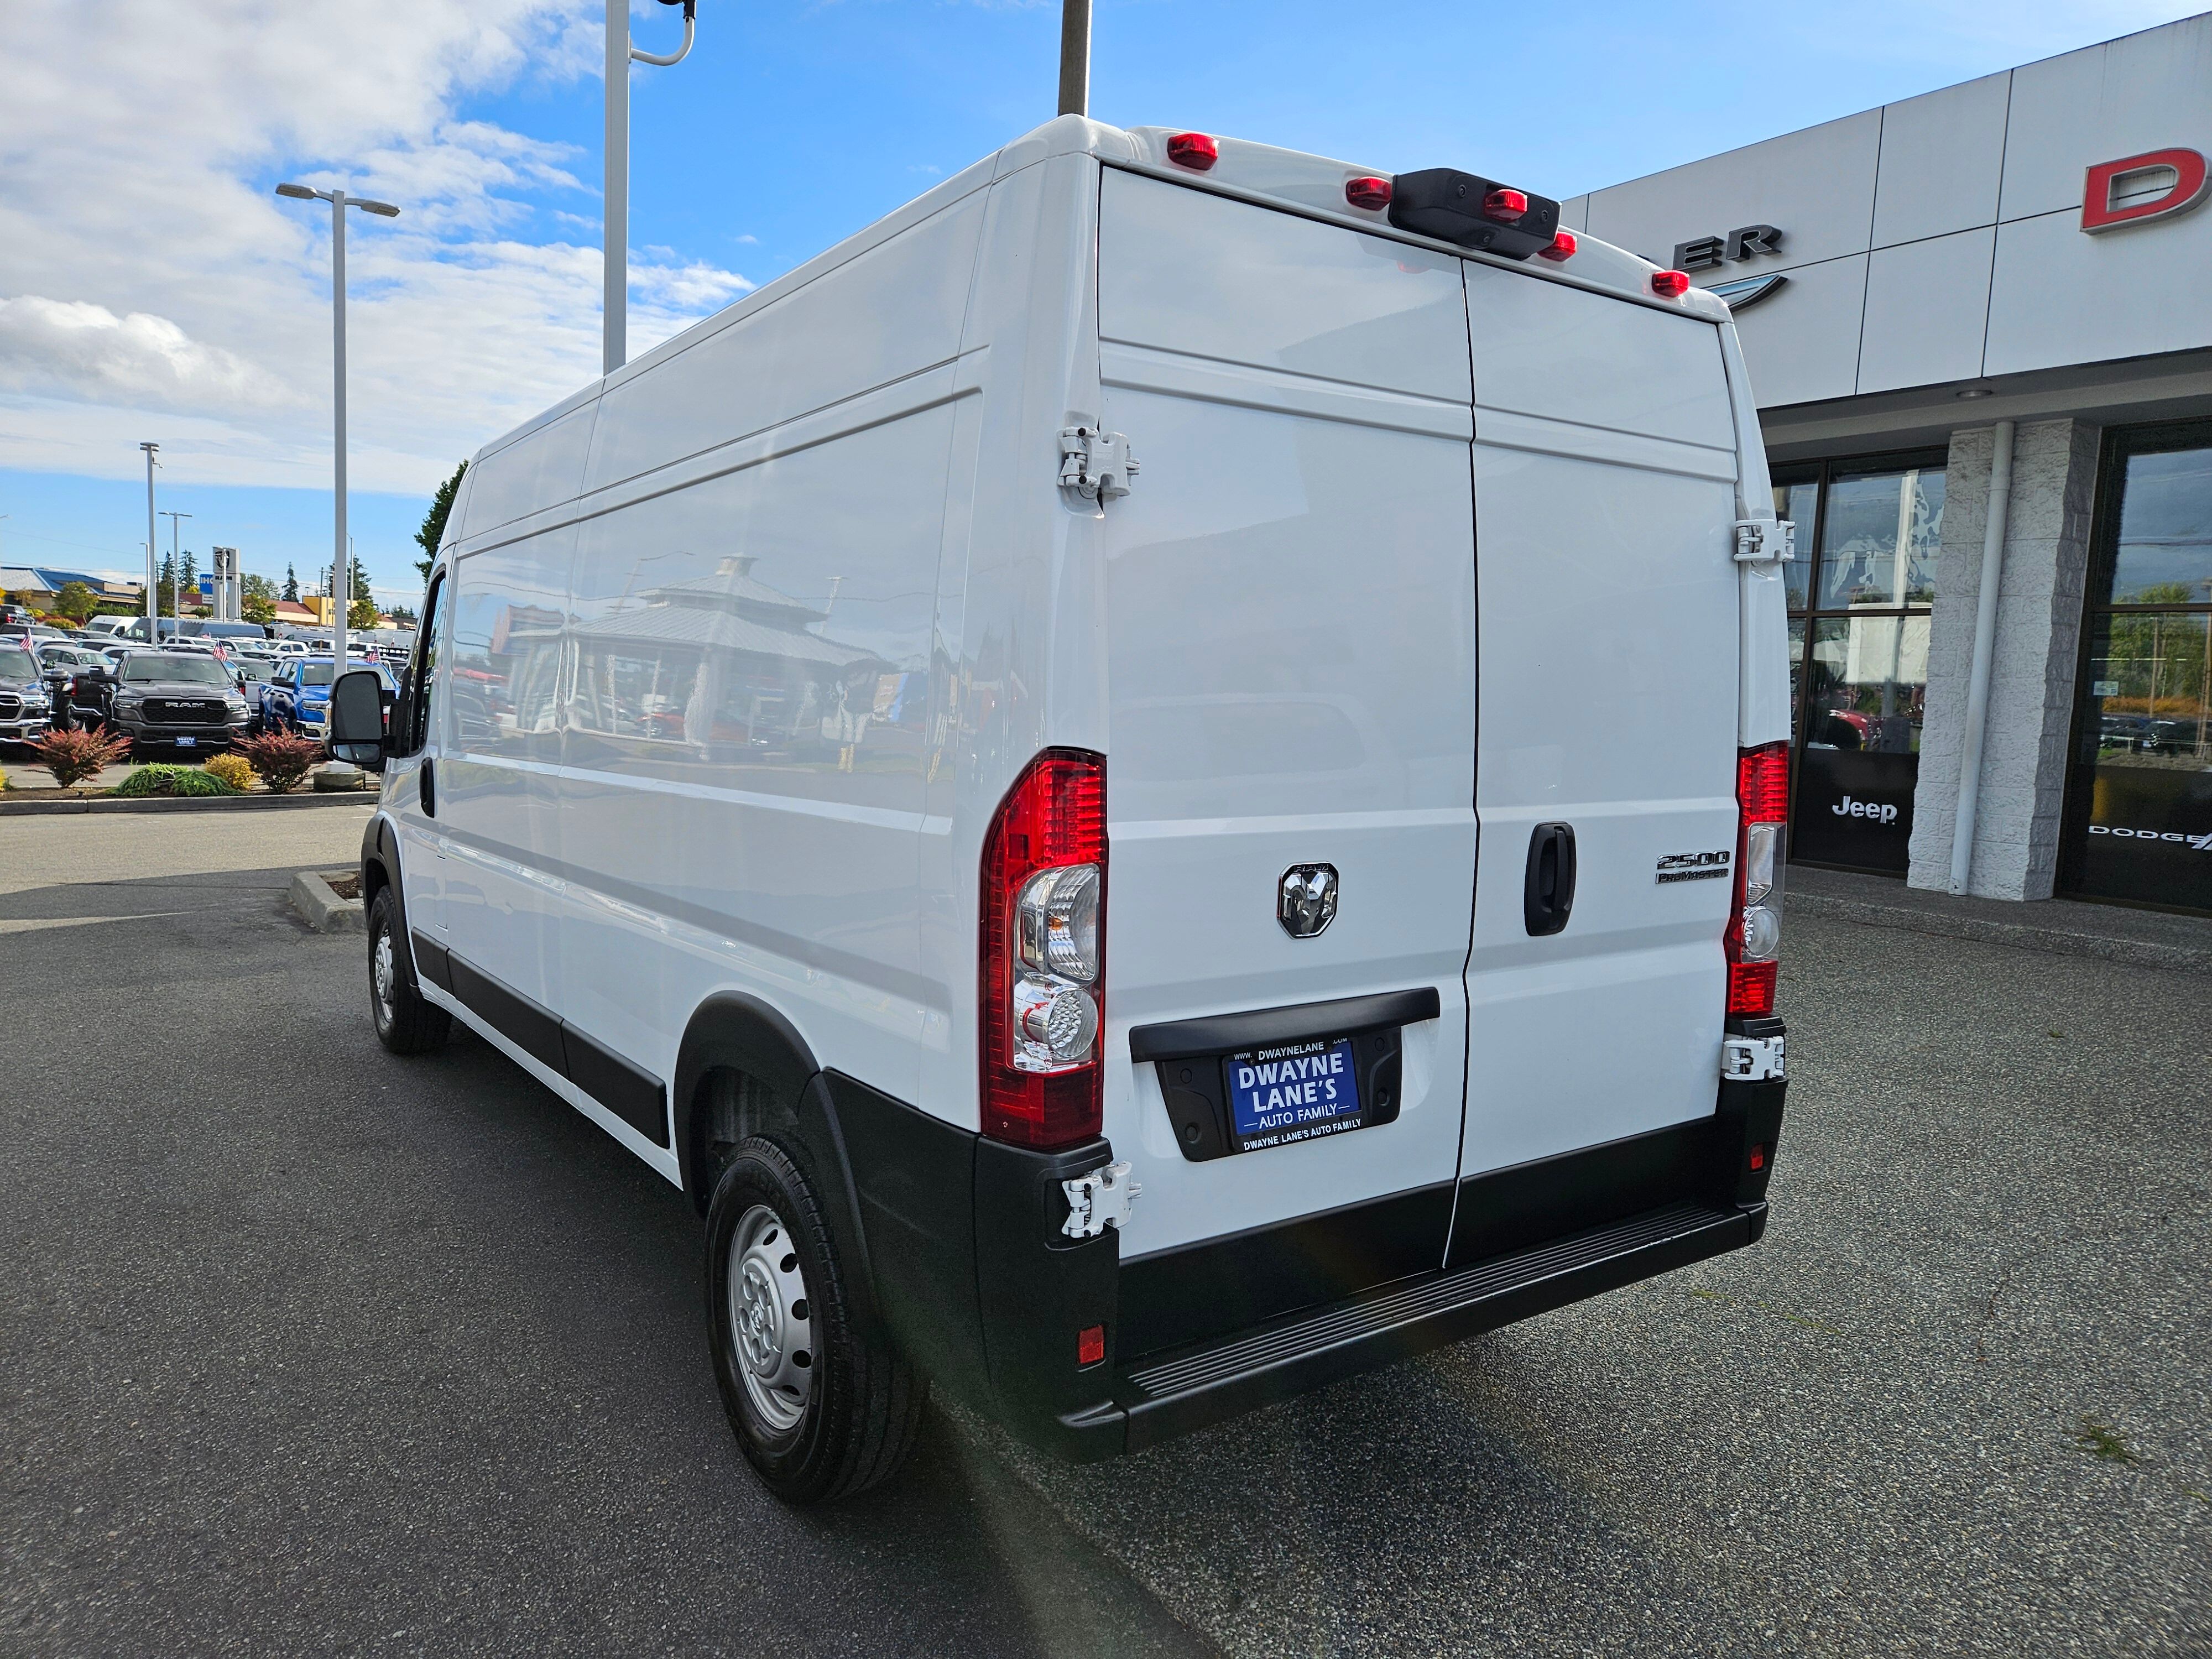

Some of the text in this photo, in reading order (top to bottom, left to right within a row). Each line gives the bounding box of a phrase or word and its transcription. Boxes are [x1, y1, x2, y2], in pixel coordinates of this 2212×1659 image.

[1832, 796, 1897, 824] Jeep
[2088, 826, 2205, 843] DODGE
[1657, 850, 1730, 869] 2500
[1258, 1041, 1324, 1061] DWAYNELANE
[1238, 1052, 1344, 1089] DWAYNE
[1253, 1078, 1337, 1113] LANE'S
[1259, 1103, 1338, 1129] AUTO FAMILY
[1244, 1118, 1361, 1151] DWAYNE LANE'S AUTO FAMILY
